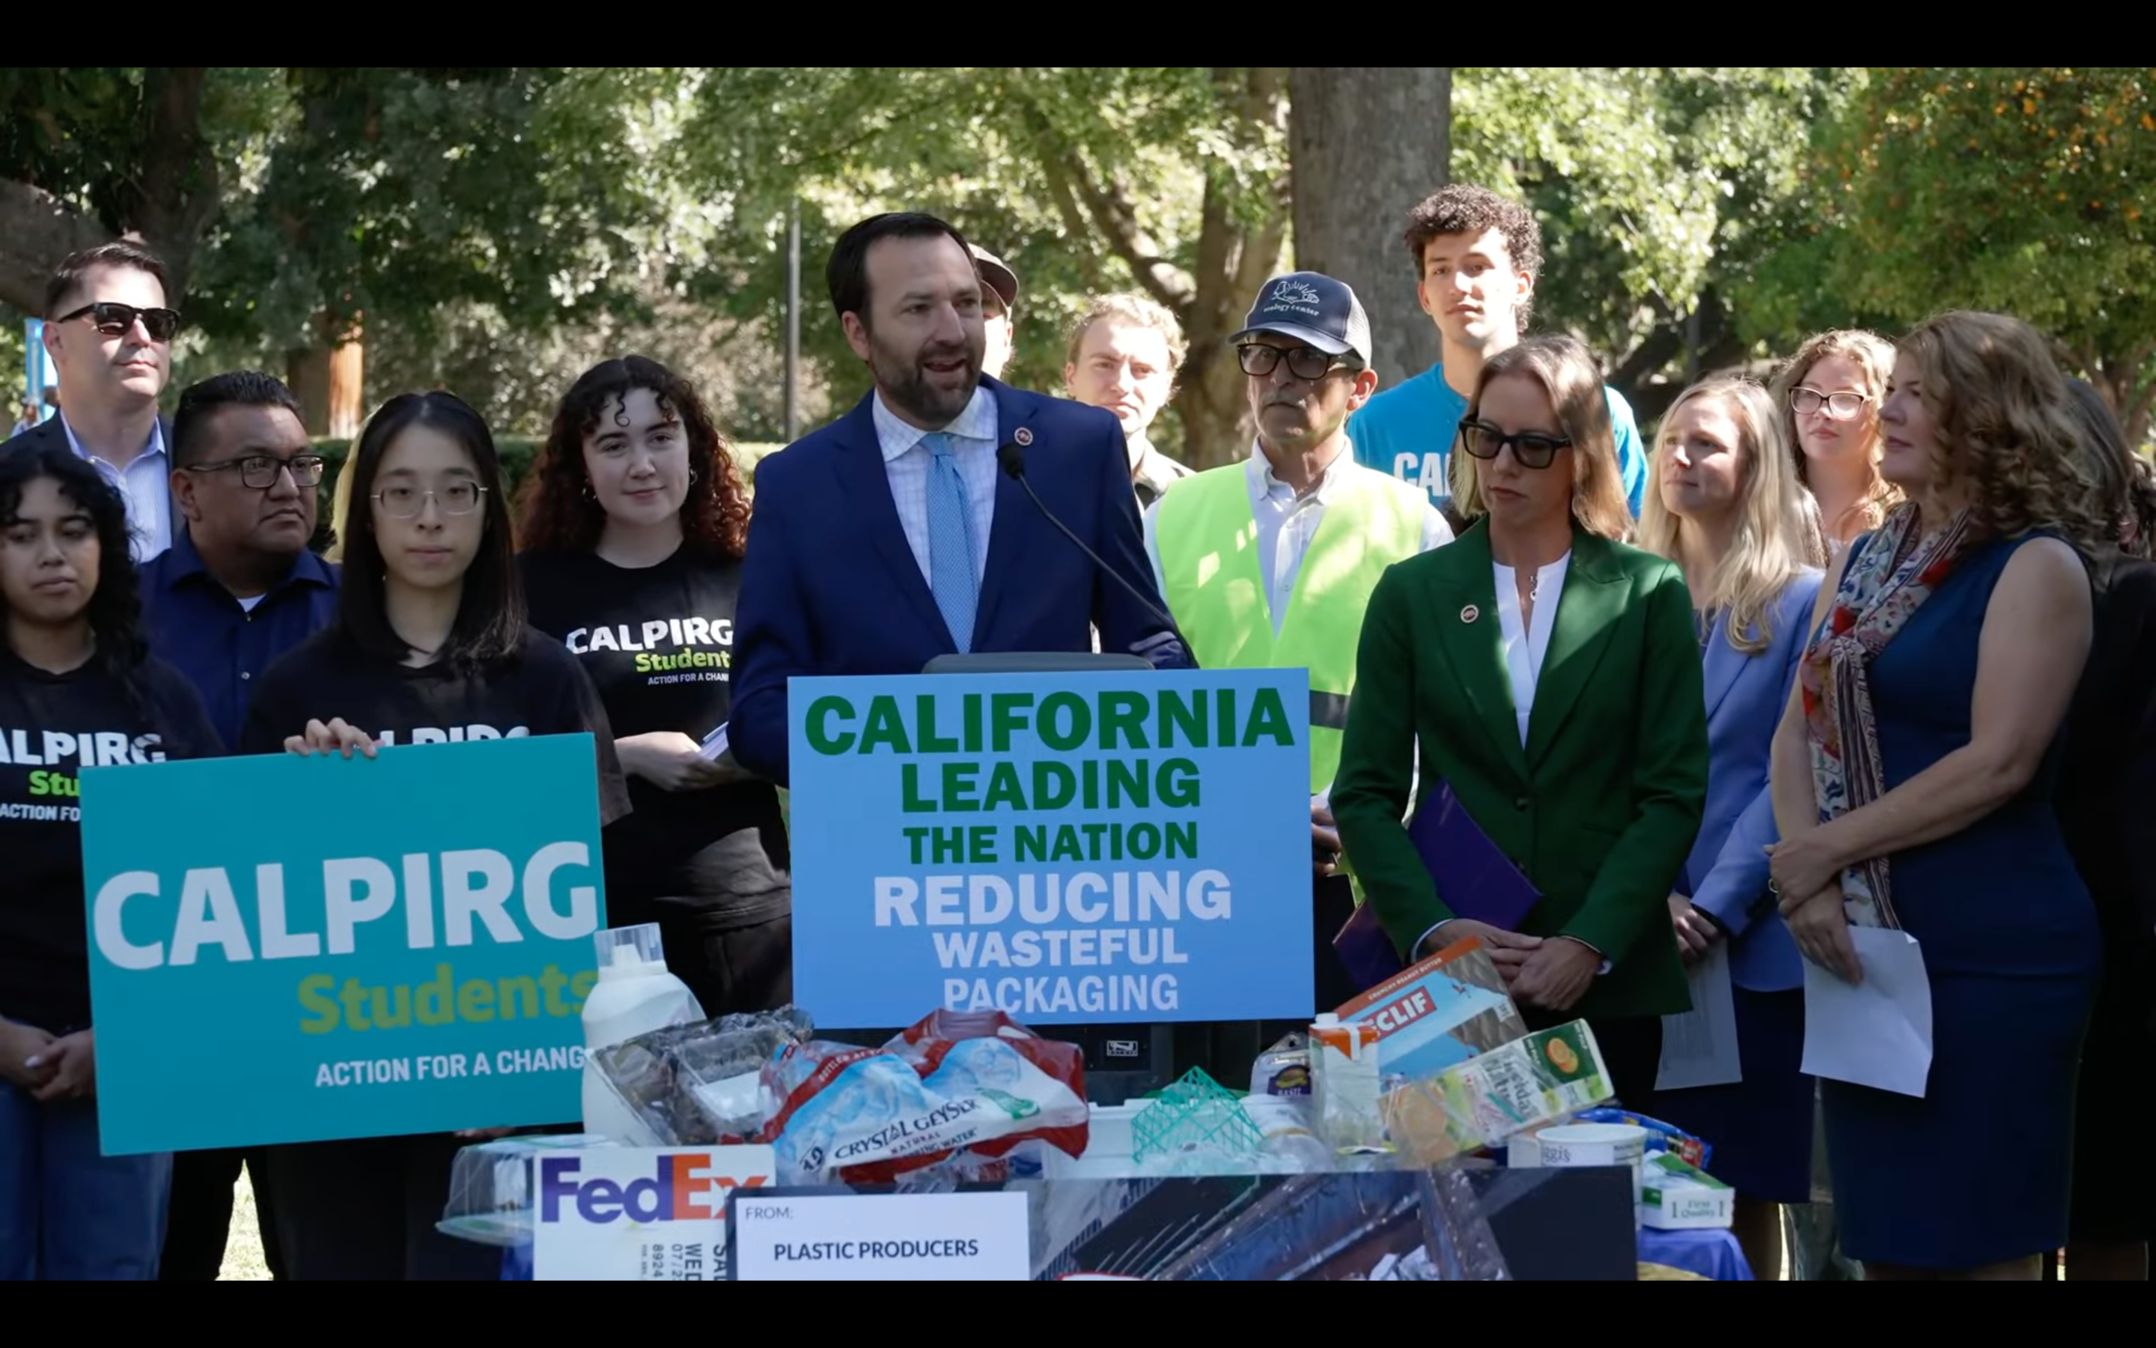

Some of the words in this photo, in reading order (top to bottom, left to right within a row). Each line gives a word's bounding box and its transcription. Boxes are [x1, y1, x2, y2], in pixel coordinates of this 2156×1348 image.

[1263, 303, 1290, 313] ecology
[1291, 305, 1319, 316] center
[1394, 452, 1452, 496] CA
[566, 617, 733, 654] CALPIRG
[648, 675, 678, 685] ACTION
[680, 673, 696, 682] FOR
[698, 673, 704, 681] A
[805, 687, 1294, 755] CALIFORNIA
[902, 757, 1201, 812] LEADING
[0, 803, 57, 821] ACTION
[903, 826, 998, 864] THE
[1014, 822, 1197, 862] NATION
[94, 841, 599, 970] CALPIRG
[874, 869, 1232, 926] REDUCING
[933, 928, 1188, 968] WASTEFUL
[944, 974, 1179, 1013] PACKAGING
[1368, 983, 1396, 999] CRUNCHY
[1397, 970, 1419, 984] PEANUT
[1421, 958, 1442, 973] BUTTER
[298, 963, 599, 1034] Students
[1376, 992, 1427, 1031] CLIF
[315, 1052, 411, 1087] ACTION
[417, 1053, 468, 1081] FOR
[473, 1051, 492, 1076] A
[834, 1121, 914, 1159] CRYSTAL
[914, 1099, 980, 1131] GEYSER
[890, 1131, 941, 1154] NATURAL
[941, 1129, 976, 1150] WATER
[745, 1206, 794, 1220] FROM:
[652, 1244, 664, 1278] 8924
[672, 1243, 683, 1281] 07/2
[774, 1242, 854, 1260] PLASTIC
[859, 1239, 979, 1259] PRODUCERS
